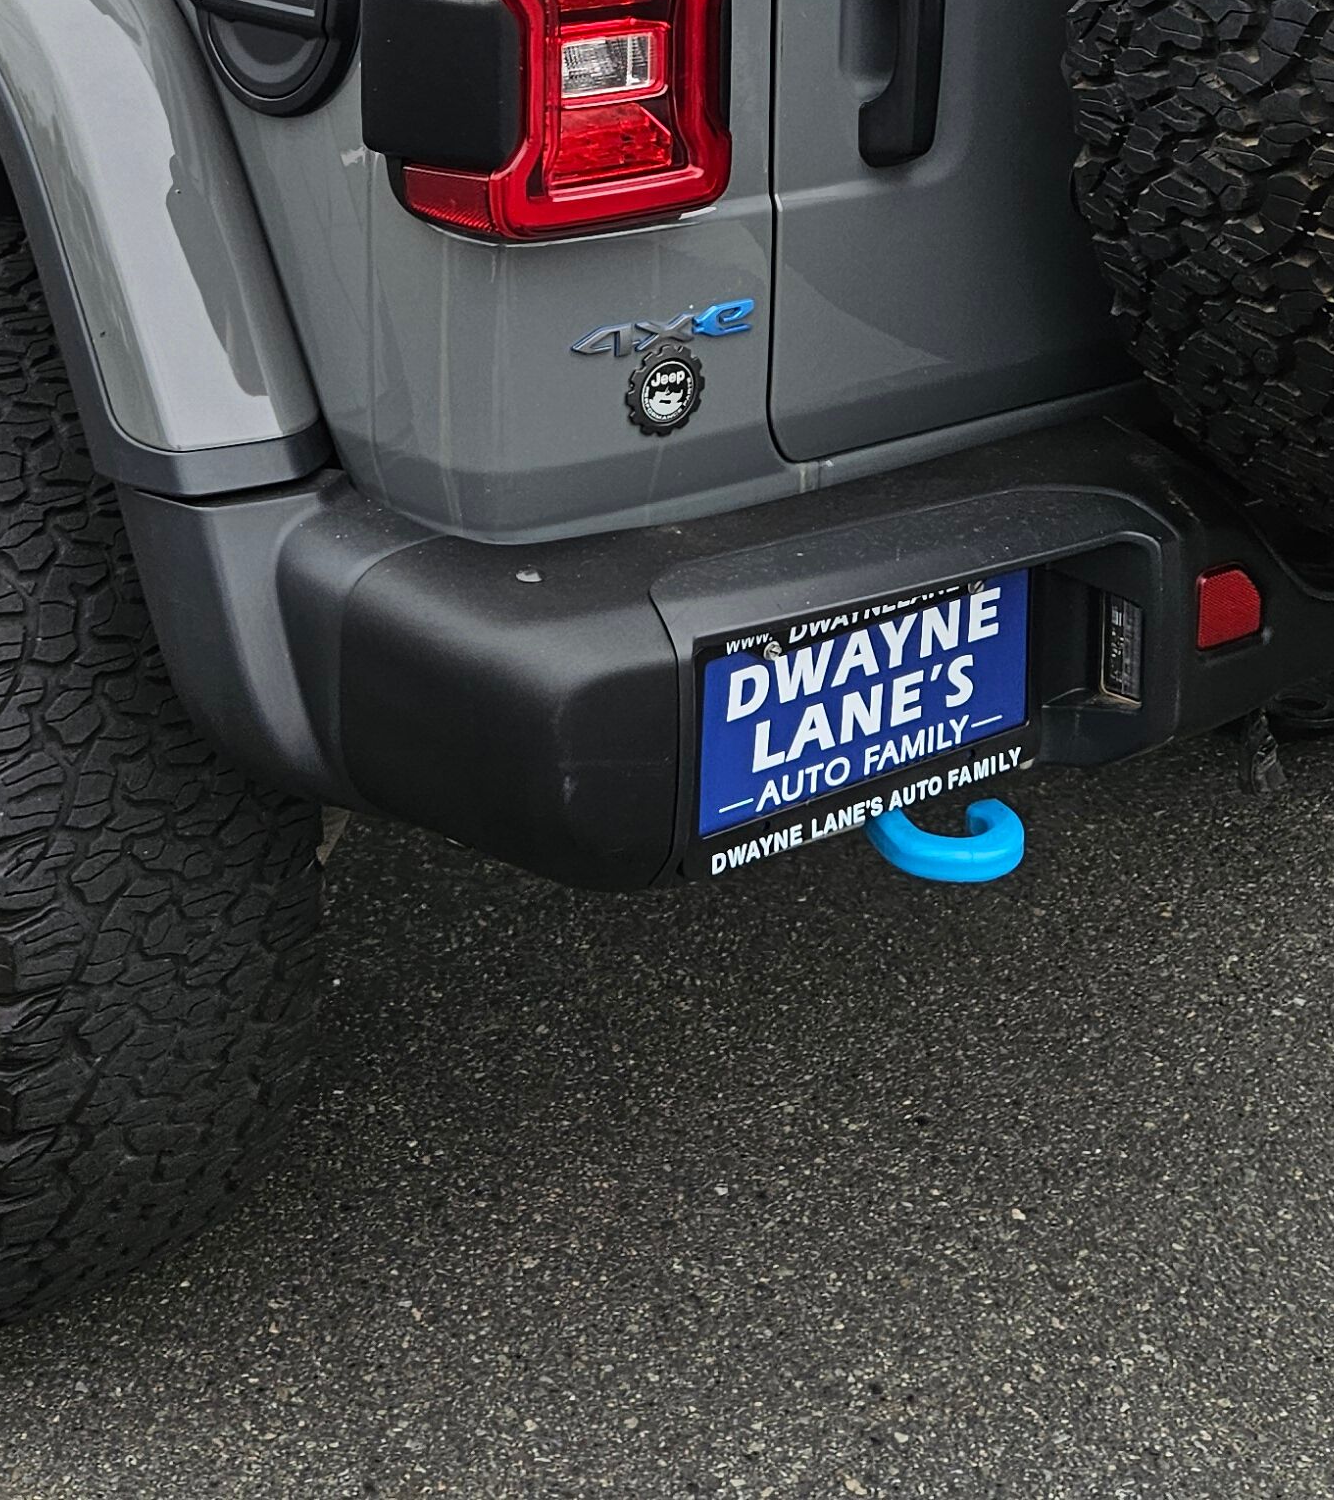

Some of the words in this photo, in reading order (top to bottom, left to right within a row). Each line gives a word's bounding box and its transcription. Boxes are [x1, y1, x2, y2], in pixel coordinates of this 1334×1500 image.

[650, 370, 686, 388] Jeep
[725, 587, 1002, 722] DWAYNE
[751, 654, 975, 774] LANE'S
[711, 823, 804, 876] DWAYNE
[810, 794, 884, 842] LANE'S
[888, 776, 943, 812] AUTO
[946, 746, 1023, 791] FAMILY
[755, 756, 851, 813] AUTO
[862, 714, 971, 776] FAMILY
